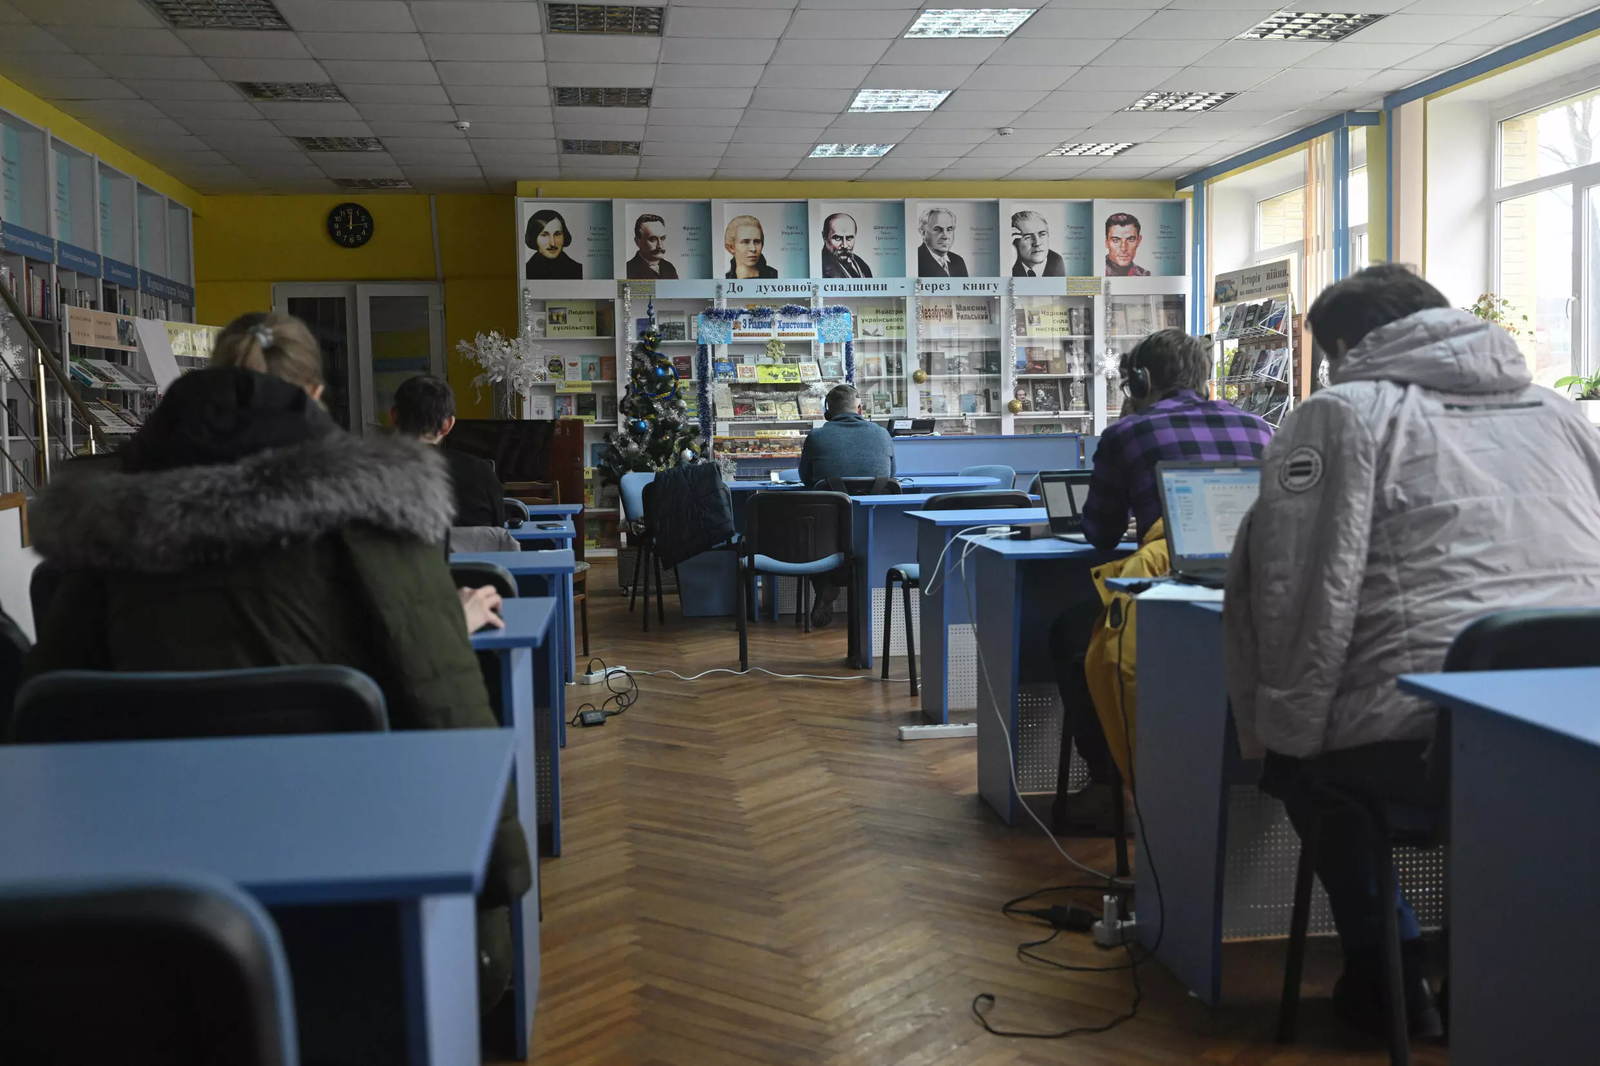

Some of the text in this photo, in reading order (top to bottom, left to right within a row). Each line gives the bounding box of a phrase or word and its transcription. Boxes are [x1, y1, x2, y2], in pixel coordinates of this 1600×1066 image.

[726, 282, 744, 294] До
[755, 281, 812, 295] духовної
[823, 283, 888, 294] спадщини
[962, 283, 999, 293] книгу
[955, 304, 987, 312] Максим
[956, 312, 989, 321] Рильський
